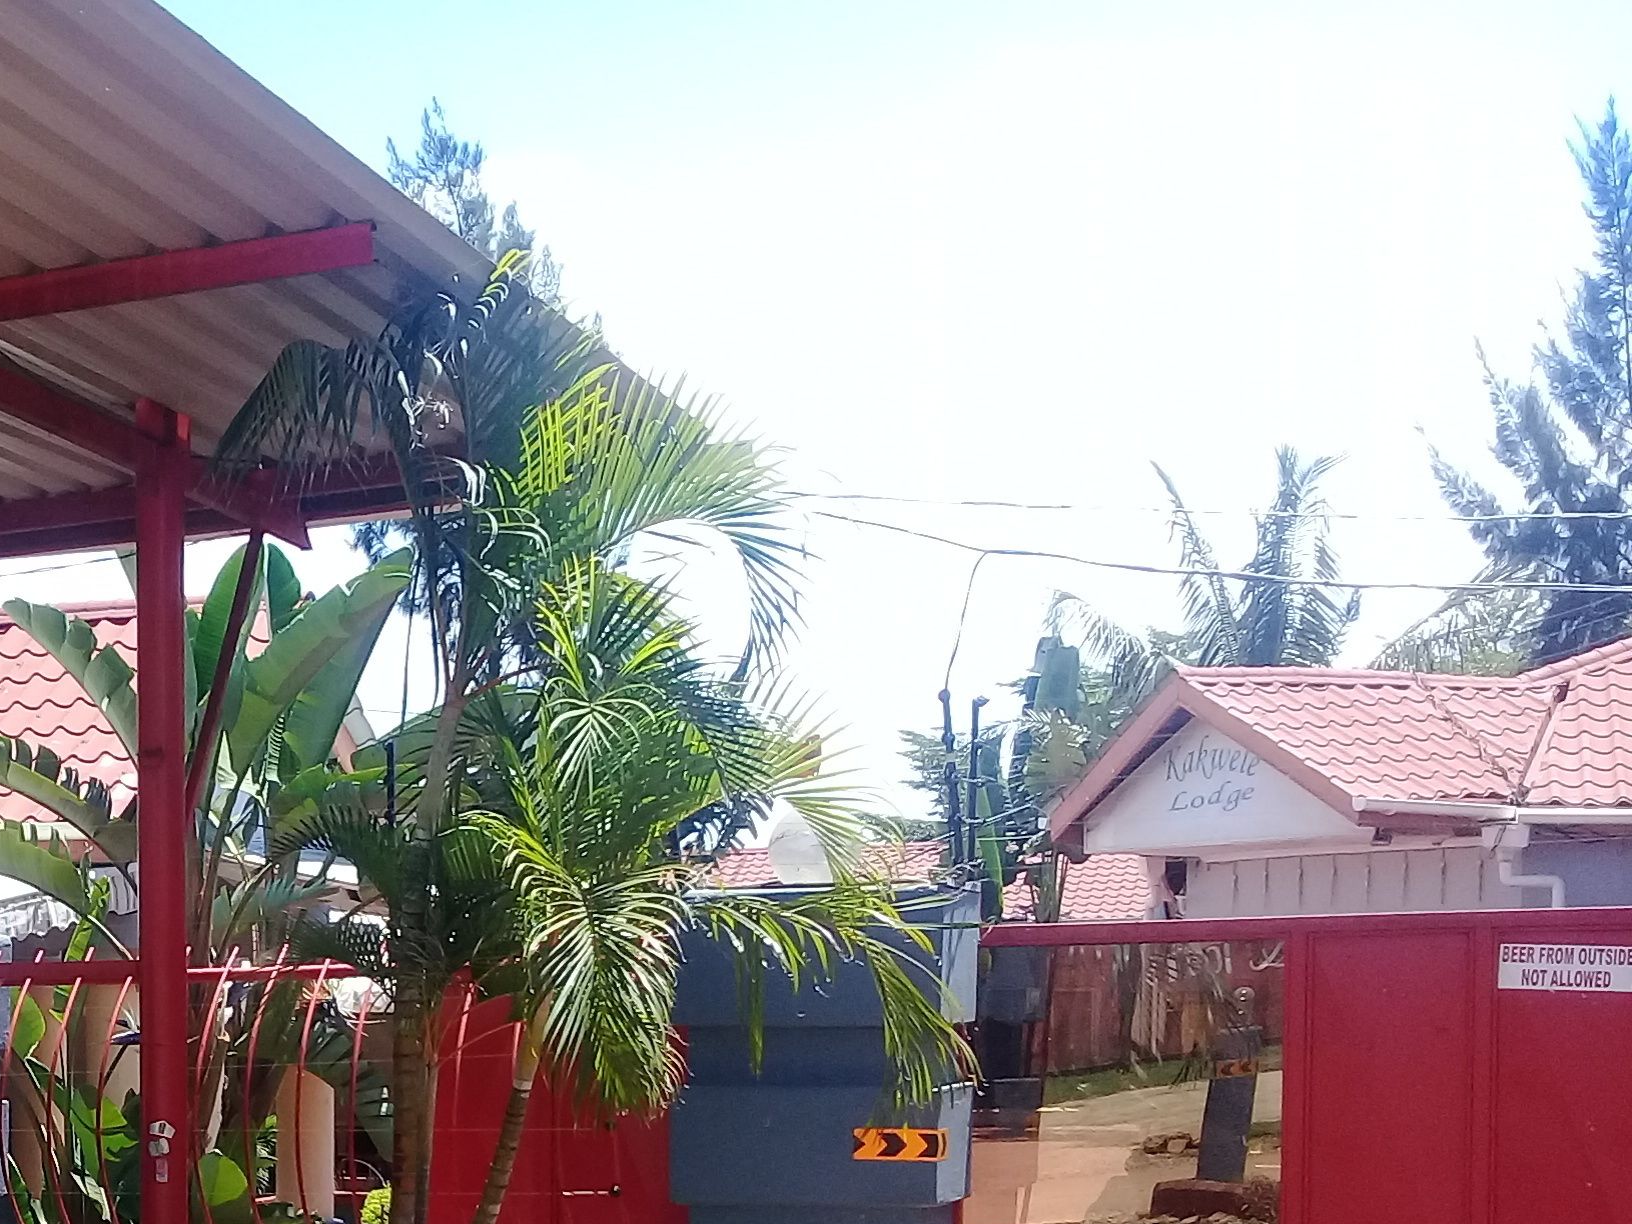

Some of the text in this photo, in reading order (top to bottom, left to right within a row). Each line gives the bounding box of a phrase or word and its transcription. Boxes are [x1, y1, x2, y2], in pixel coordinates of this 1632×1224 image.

[1164, 735, 1259, 782] Kakwele
[1168, 780, 1255, 812] Lodge
[1502, 946, 1632, 966] BEER FROM OUTSIDE
[1521, 969, 1612, 988] NOT ALLOWED
